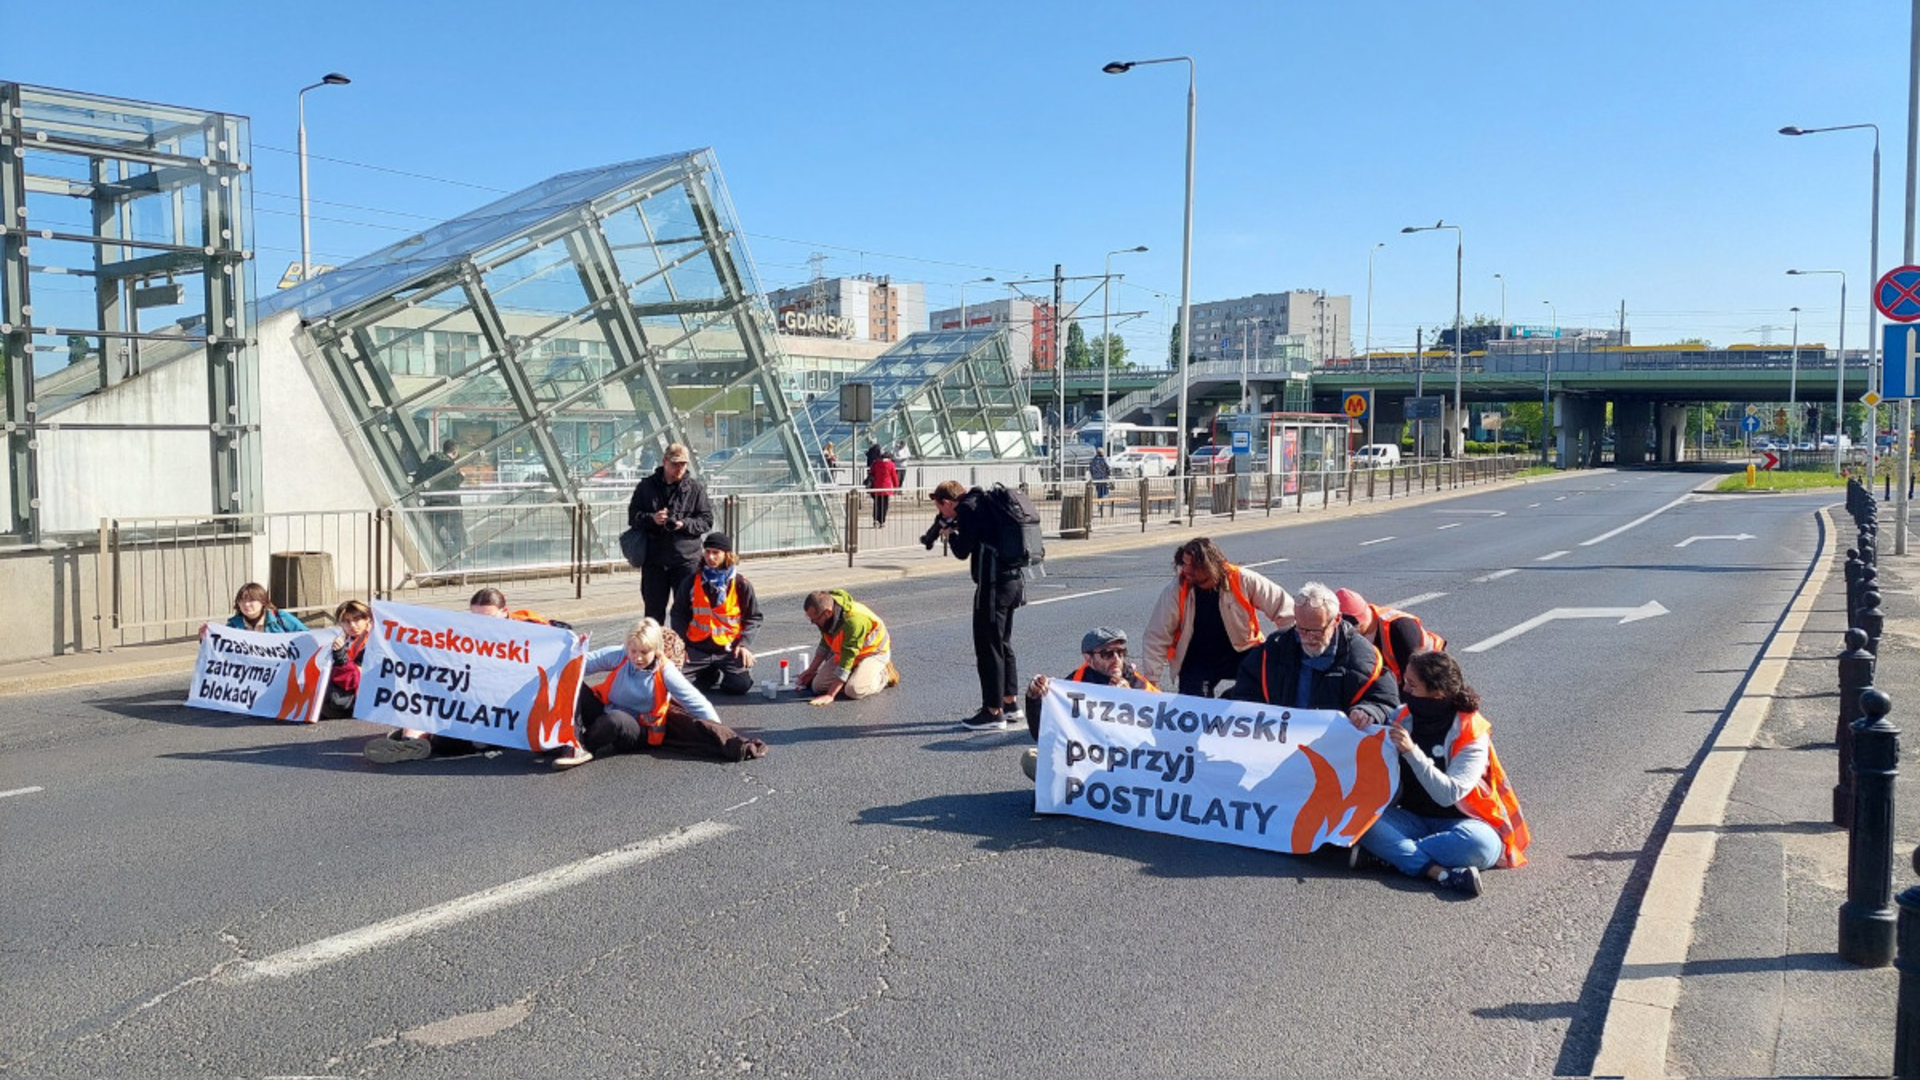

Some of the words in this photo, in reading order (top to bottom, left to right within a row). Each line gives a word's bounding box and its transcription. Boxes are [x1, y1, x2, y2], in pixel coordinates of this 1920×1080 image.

[1347, 398, 1363, 413] M
[210, 633, 300, 660] Trzaskowski
[382, 617, 529, 664] Trzaskowski
[206, 659, 280, 687] zatrzymaj
[380, 657, 471, 692] poprzyj
[199, 679, 257, 710] blokady
[374, 687, 520, 731] POSTULATY
[1068, 692, 1291, 744] Trzaskowski
[1066, 739, 1195, 783] poprzyj
[1066, 777, 1278, 834] POSTULATY
